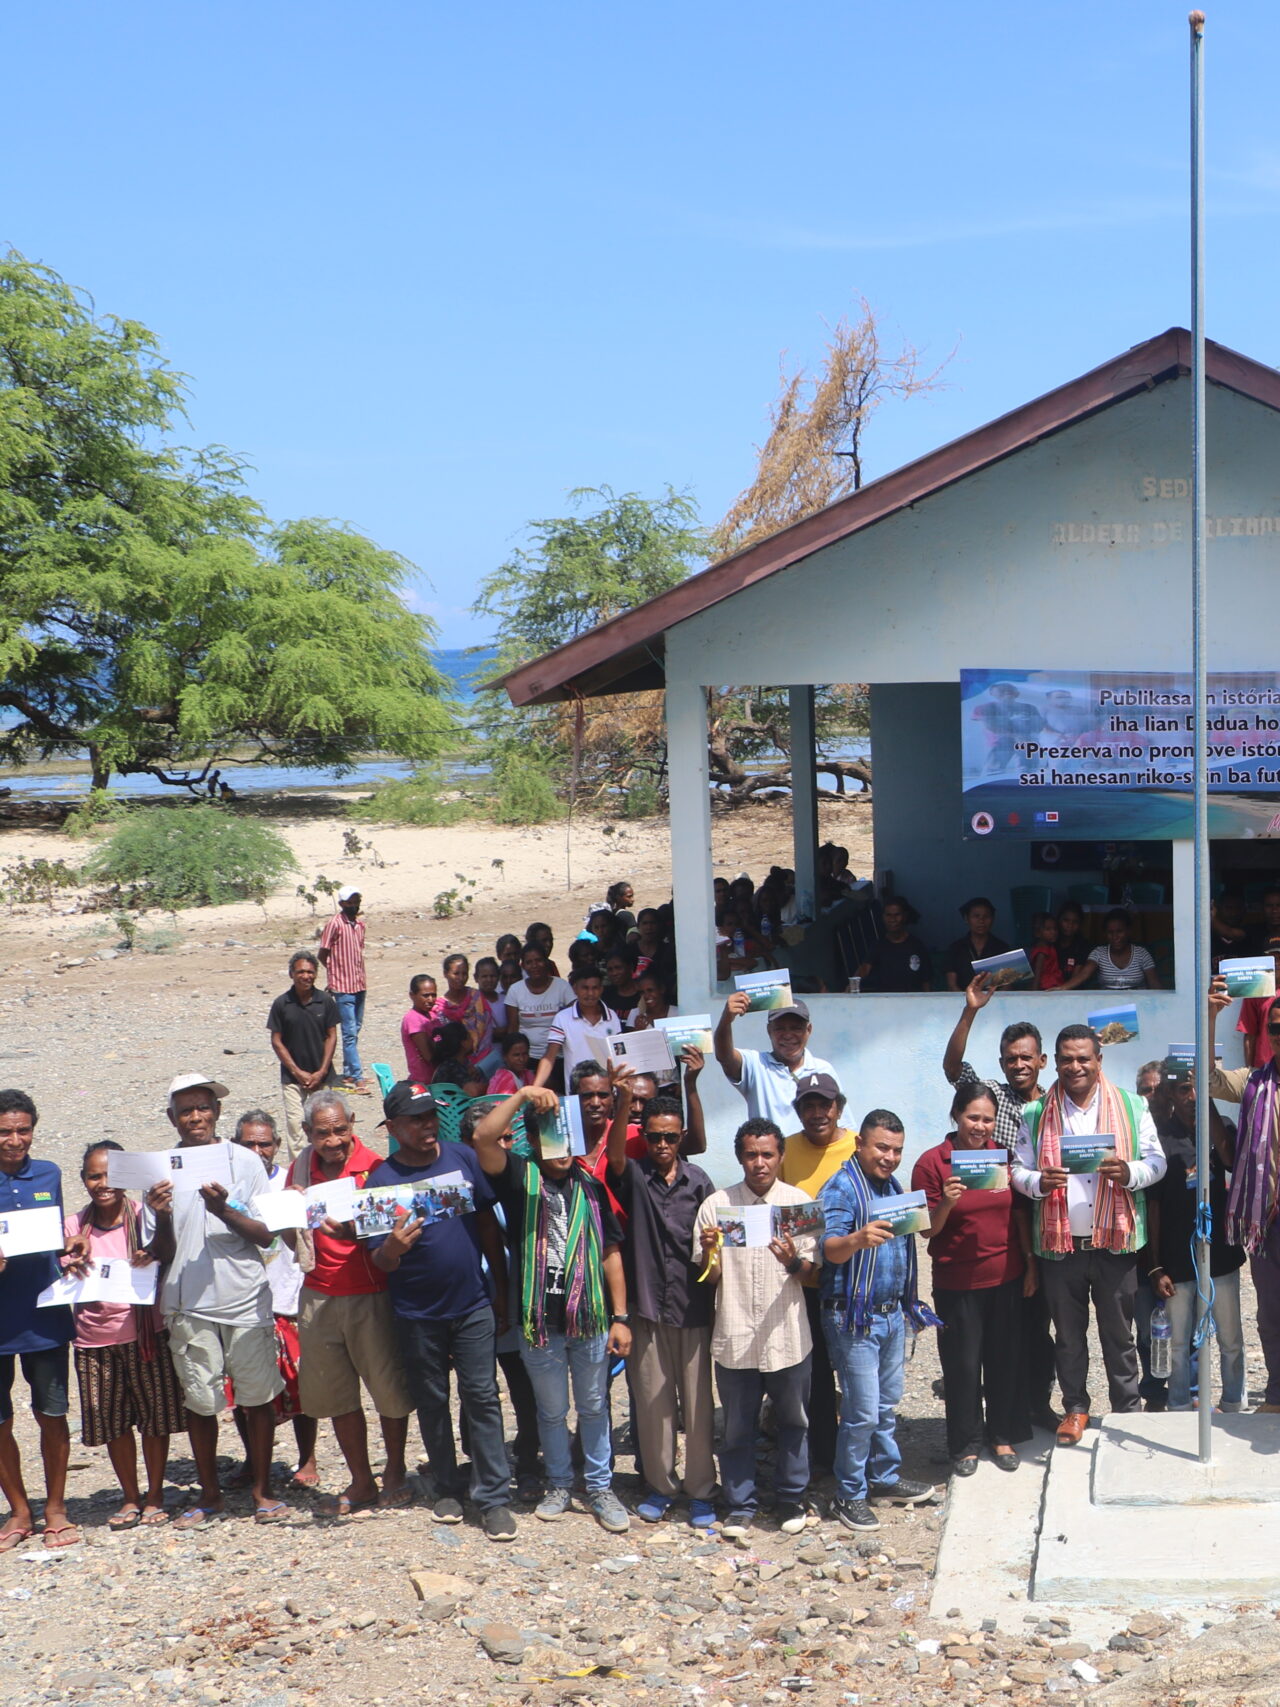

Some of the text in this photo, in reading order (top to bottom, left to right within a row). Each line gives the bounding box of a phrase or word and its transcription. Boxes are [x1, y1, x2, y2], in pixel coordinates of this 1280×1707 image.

[1142, 477, 1193, 498] SED
[1051, 521, 1140, 543] ALDEIA
[1100, 690, 1216, 706] Publikasan
[1110, 716, 1139, 732] iha
[1145, 715, 1179, 732] lian
[1255, 714, 1279, 730] ho
[1014, 742, 1113, 759] “Prezerva
[1119, 746, 1143, 759] no
[1019, 769, 1045, 785] sai
[1051, 768, 1130, 785] hanesan
[1136, 768, 1222, 784] riko-sin
[1228, 767, 1251, 783] ba
[810, 1074, 819, 1086] A
